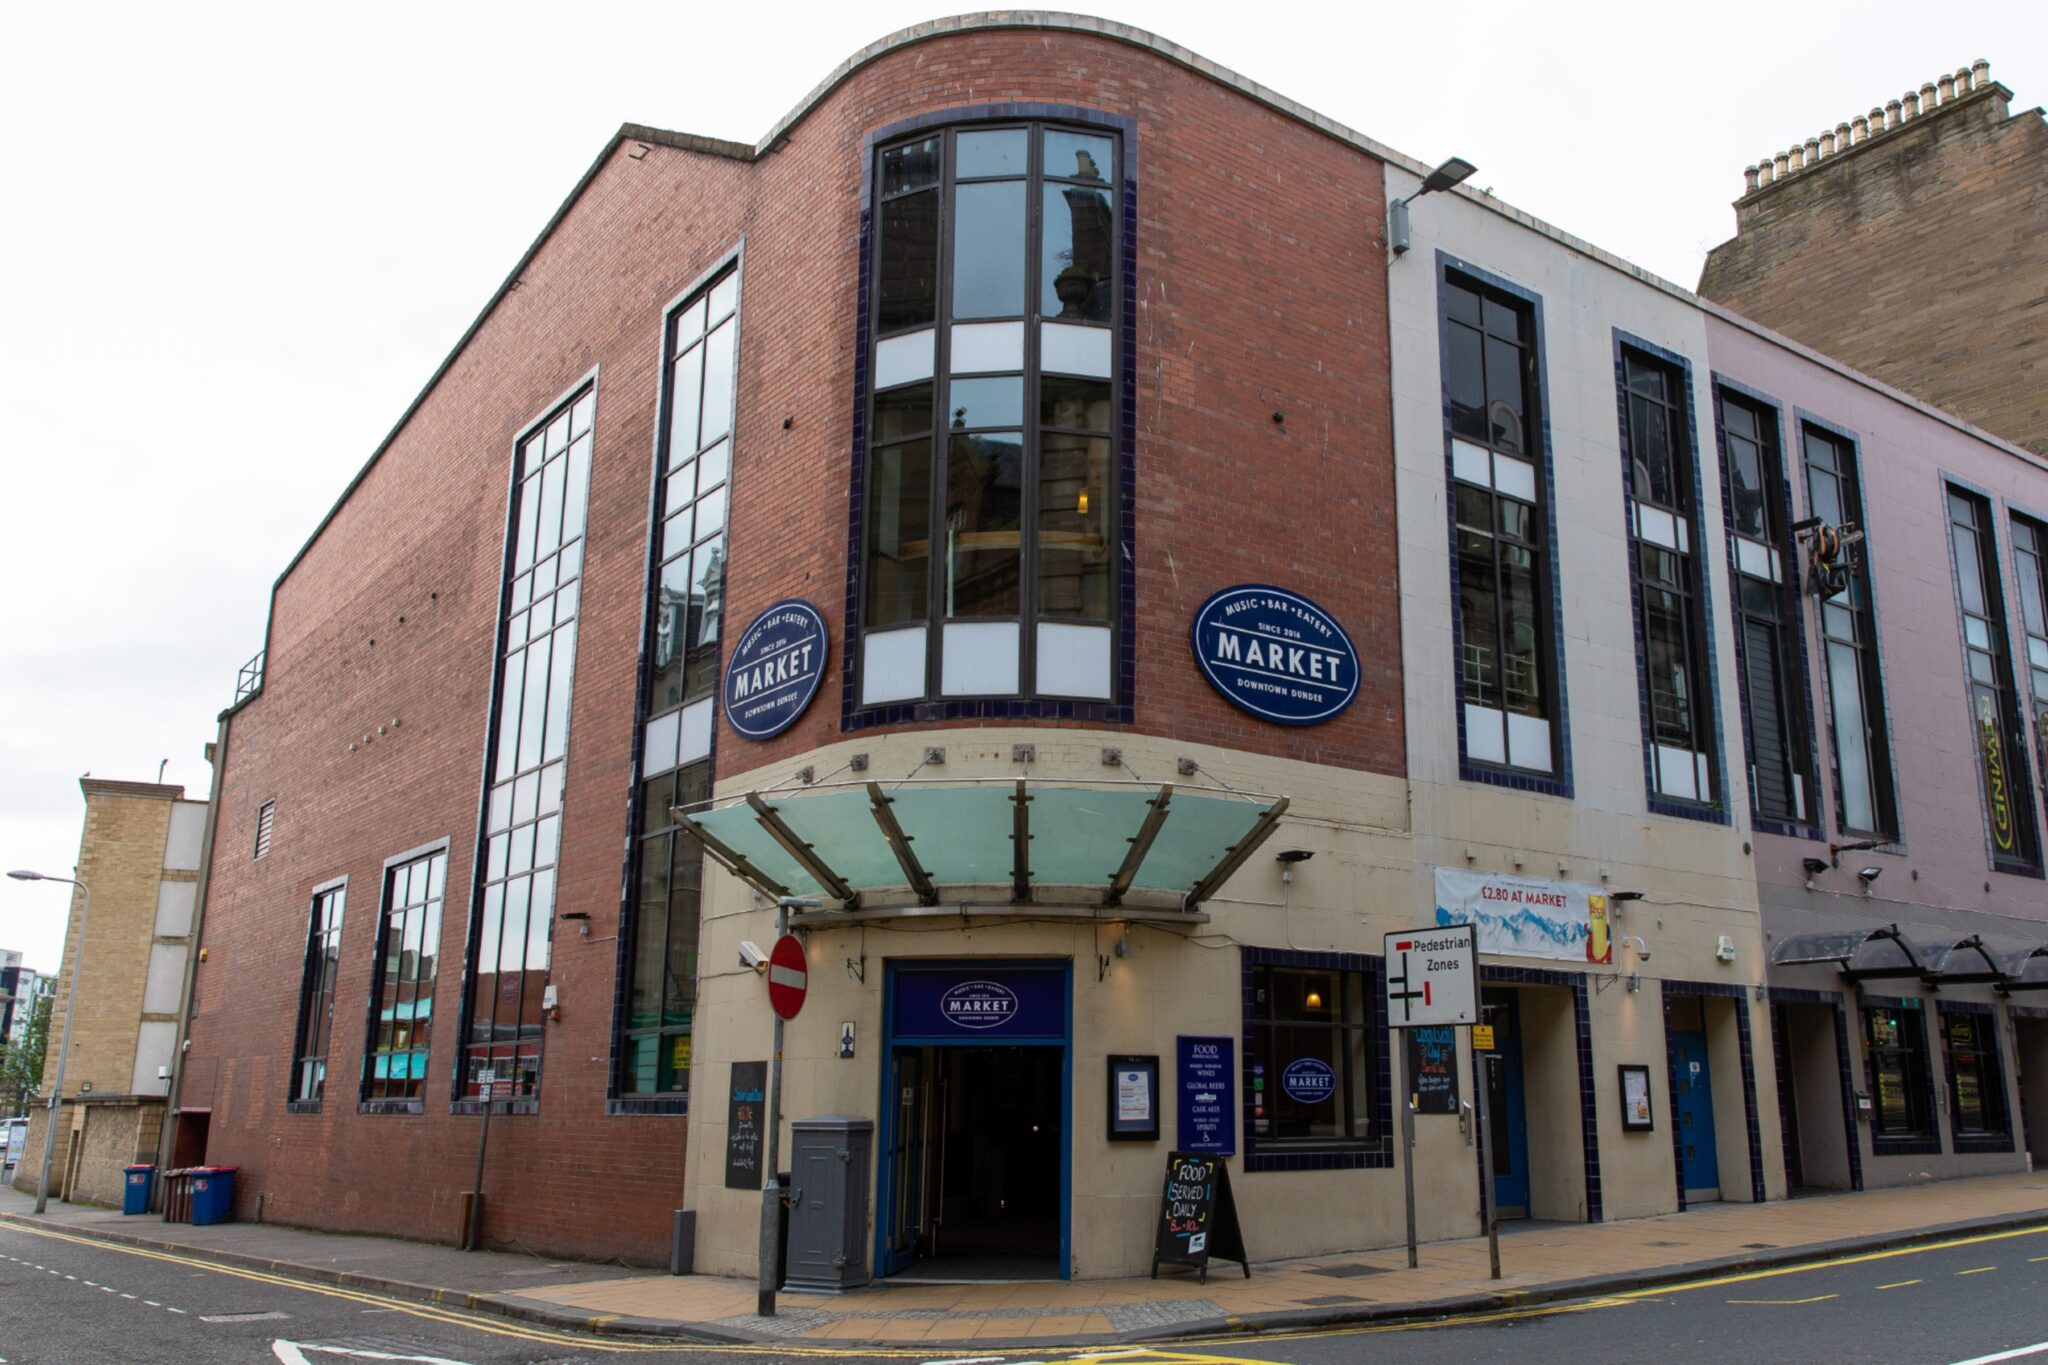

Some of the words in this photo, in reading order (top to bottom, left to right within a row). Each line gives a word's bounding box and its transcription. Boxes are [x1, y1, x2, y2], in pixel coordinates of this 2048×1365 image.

[1225, 598, 1259, 617] MUSIC
[1267, 599, 1288, 612] BAR
[1297, 609, 1332, 639] EATERY
[742, 627, 762, 656] MUSIC
[767, 615, 781, 629] BAR
[785, 612, 808, 629] EATERY
[1258, 622, 1281, 635] SINCE
[1217, 632, 1341, 682] MARKET
[735, 644, 812, 701] MARKET
[1237, 678, 1287, 697] DOWNTOWN
[1291, 689, 1323, 703] DUNDEE
[745, 701, 775, 719] DOWNTOWN
[777, 691, 798, 707] DUNDEE
[1481, 886, 1509, 902] £2.80
[1511, 890, 1523, 903] AT
[1525, 891, 1567, 908] MARKET
[1413, 937, 1471, 953] Pedestrian
[1426, 958, 1460, 972] Zones
[950, 1000, 1009, 1012] MARKET
[1193, 1044, 1218, 1055] FOOD
[1186, 1082, 1208, 1090] GLOBAL
[1209, 1082, 1225, 1090] BEERS
[1289, 1077, 1329, 1087] MARKET
[1191, 1105, 1207, 1113] CASK
[1179, 1164, 1206, 1181] FOOD
[1170, 1183, 1203, 1202] SERVED
[1172, 1201, 1198, 1218] DAILY
